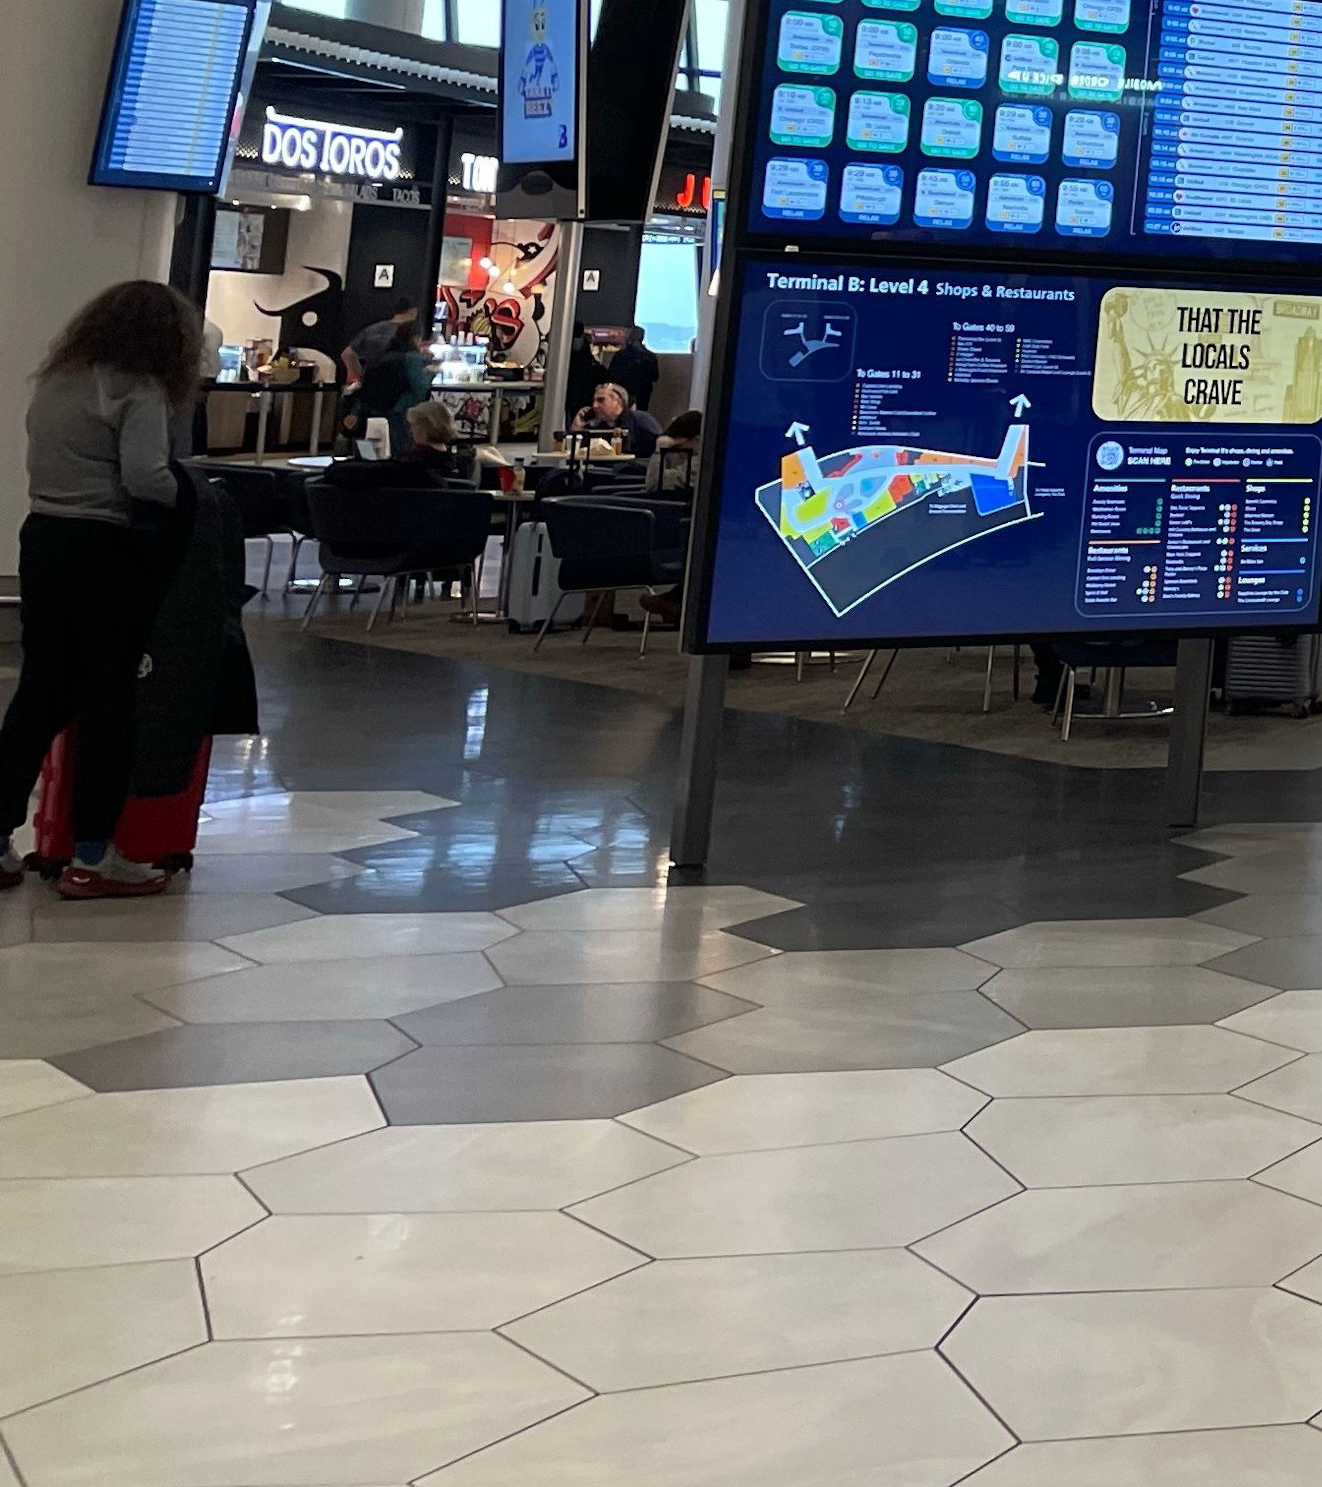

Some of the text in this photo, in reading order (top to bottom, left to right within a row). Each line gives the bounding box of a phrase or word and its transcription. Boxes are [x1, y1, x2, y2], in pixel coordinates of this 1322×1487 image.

[263, 123, 317, 168] DOS
[320, 129, 402, 181] TOROS
[766, 273, 1074, 301] Terminal B: Level 4 Shops & Restaurants
[1177, 306, 1262, 334] THAT THE
[1182, 343, 1250, 370] LOCALS
[1184, 379, 1243, 405] CRAVE
